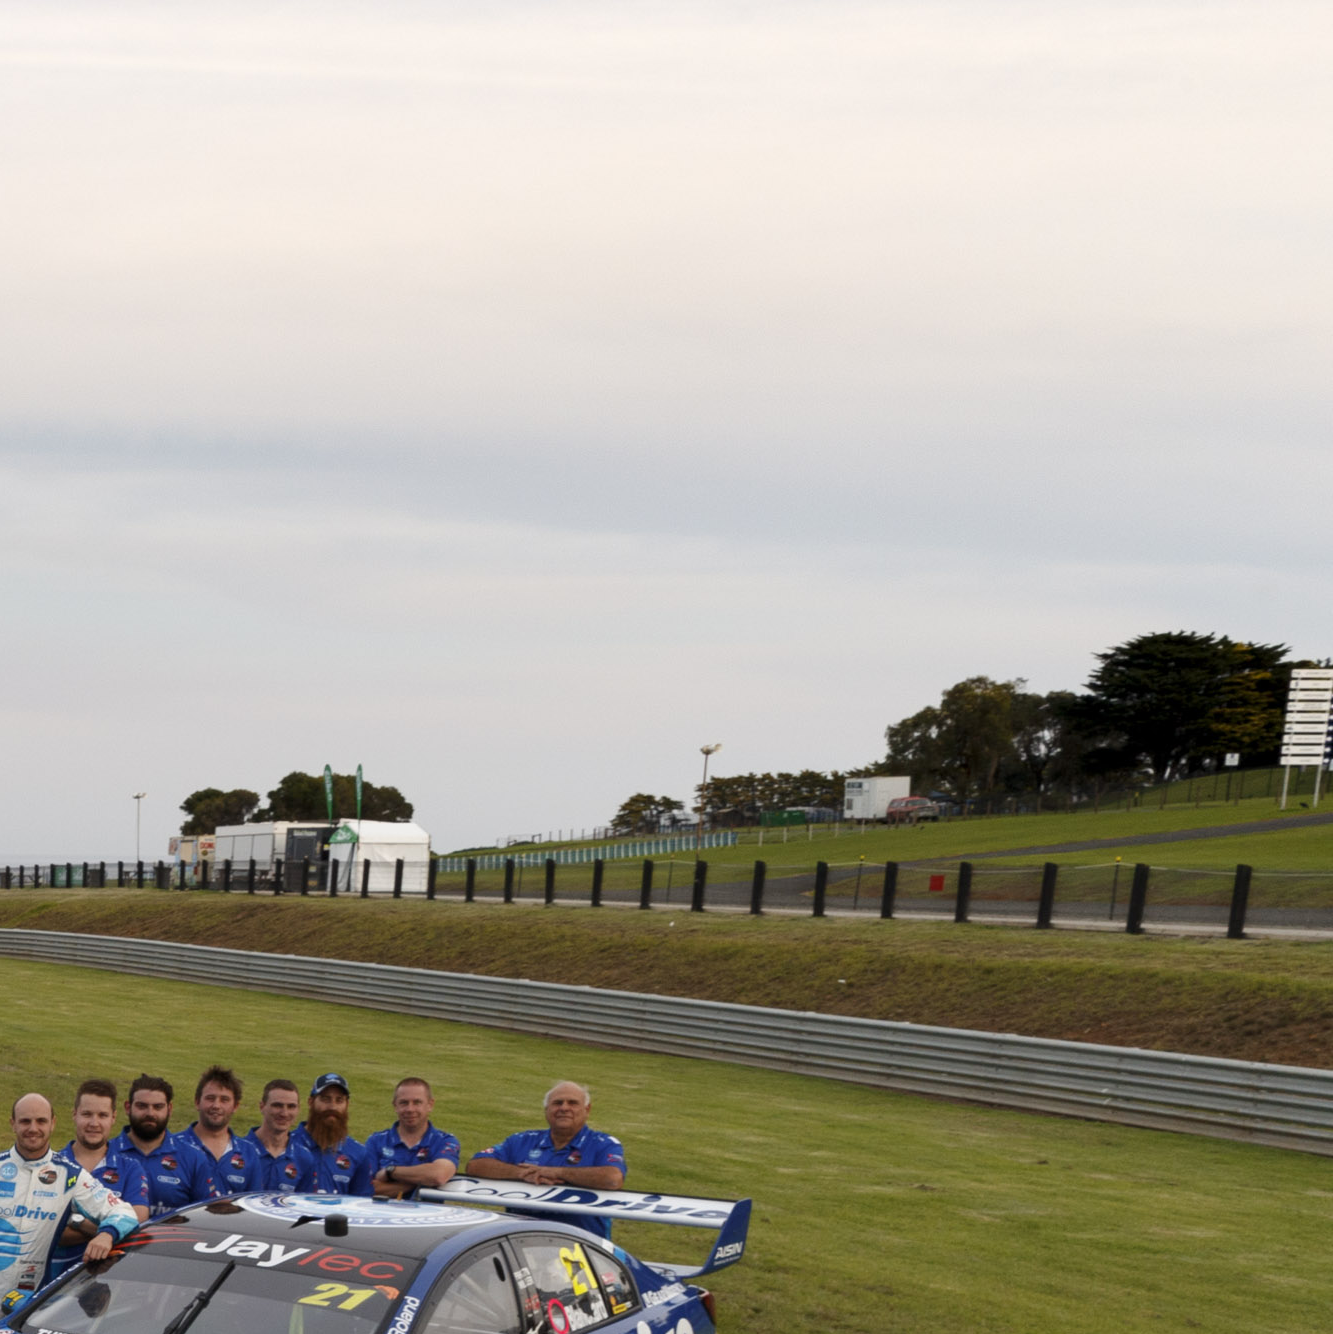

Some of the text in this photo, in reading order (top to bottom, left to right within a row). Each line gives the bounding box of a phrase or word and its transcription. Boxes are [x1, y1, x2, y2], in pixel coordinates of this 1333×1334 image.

[442, 1177, 731, 1219] CoolDrive
[193, 1233, 405, 1281] Jaylec
[559, 1242, 598, 1297] 21
[714, 1241, 743, 1259] AISIN
[297, 1283, 378, 1311] 21
